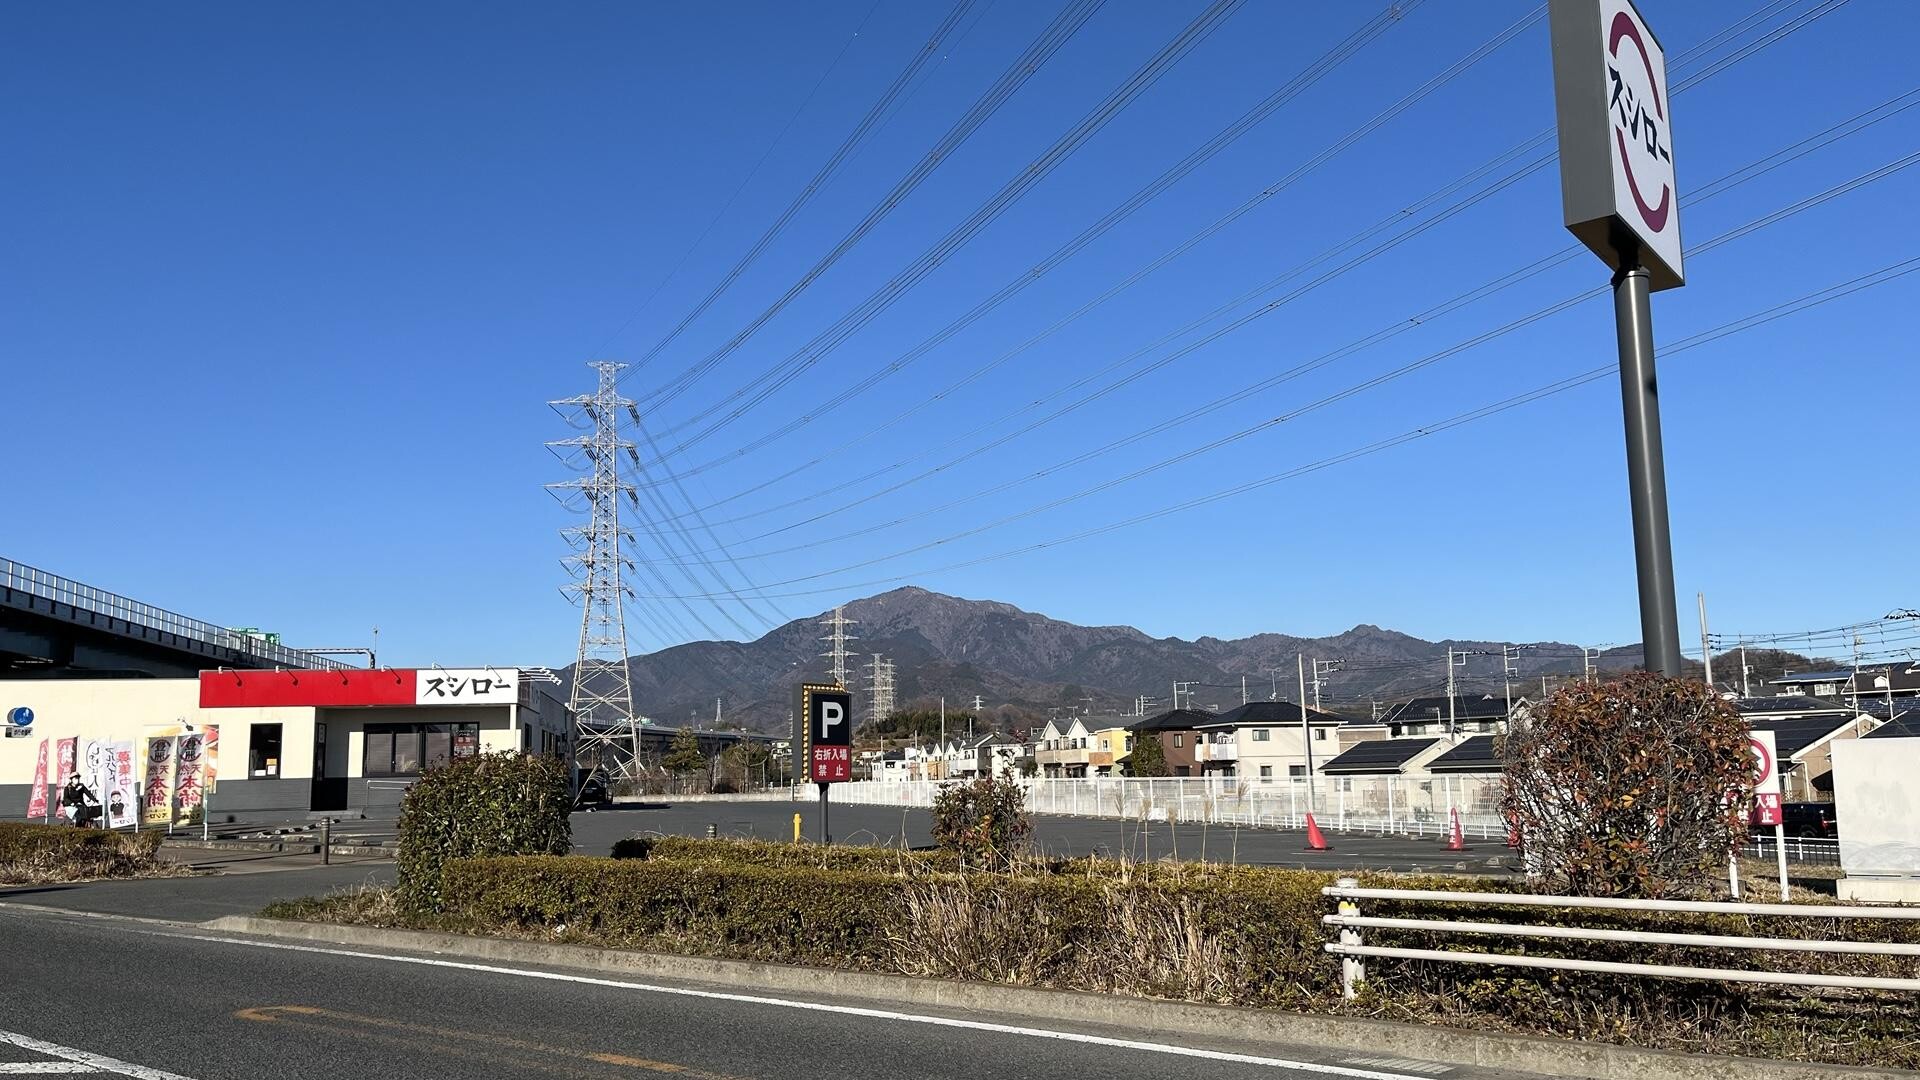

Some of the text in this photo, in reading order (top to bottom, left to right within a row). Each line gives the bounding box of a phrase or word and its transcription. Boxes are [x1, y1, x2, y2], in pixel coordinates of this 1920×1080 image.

[1607, 62, 1671, 165] スシロー
[423, 677, 511, 698] スシロー
[822, 701, 844, 738] P
[814, 748, 848, 761] 右折入場
[818, 764, 844, 777] 禁止
